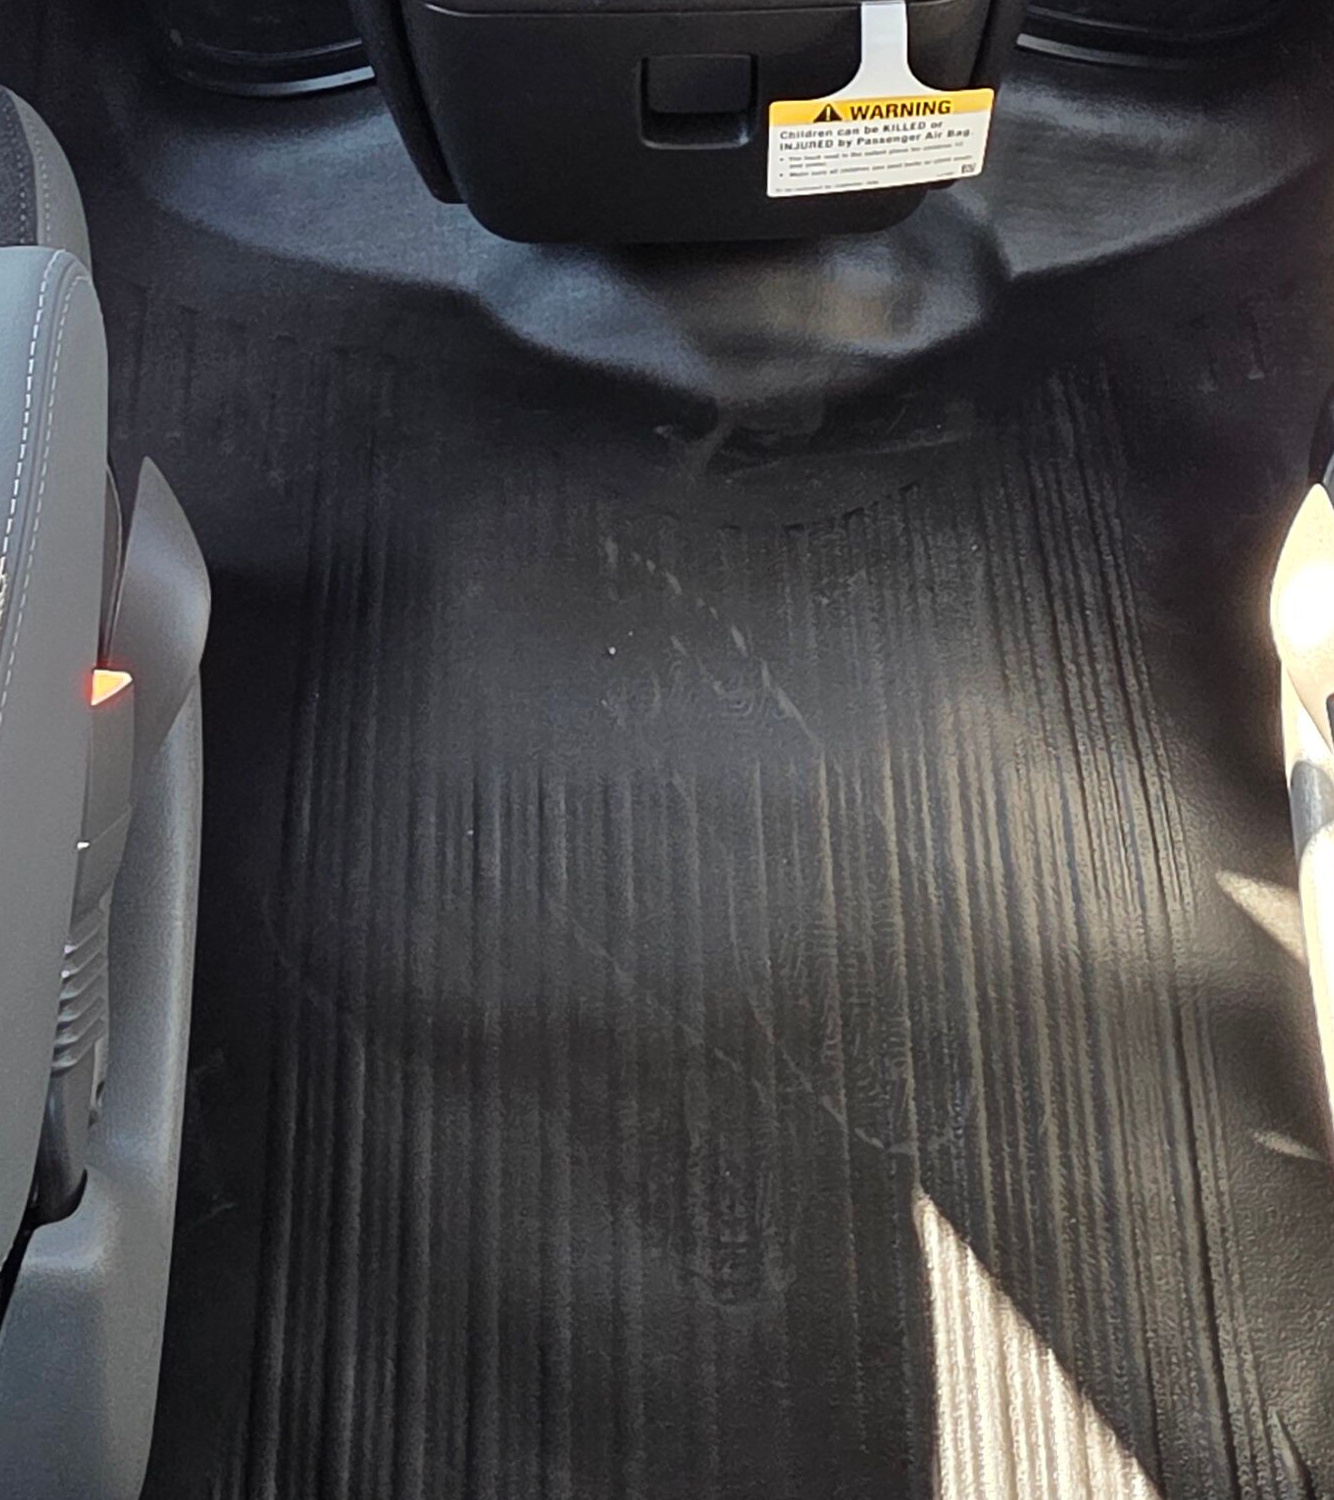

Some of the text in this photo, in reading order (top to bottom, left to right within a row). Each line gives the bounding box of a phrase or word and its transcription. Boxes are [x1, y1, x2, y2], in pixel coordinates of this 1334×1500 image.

[849, 100, 952, 121] WARNING
[779, 121, 943, 140] Children can be KILLED or
[779, 139, 834, 152] INJURED
[837, 139, 852, 148] by
[856, 133, 921, 146] Passenger
[925, 131, 943, 140] Air
